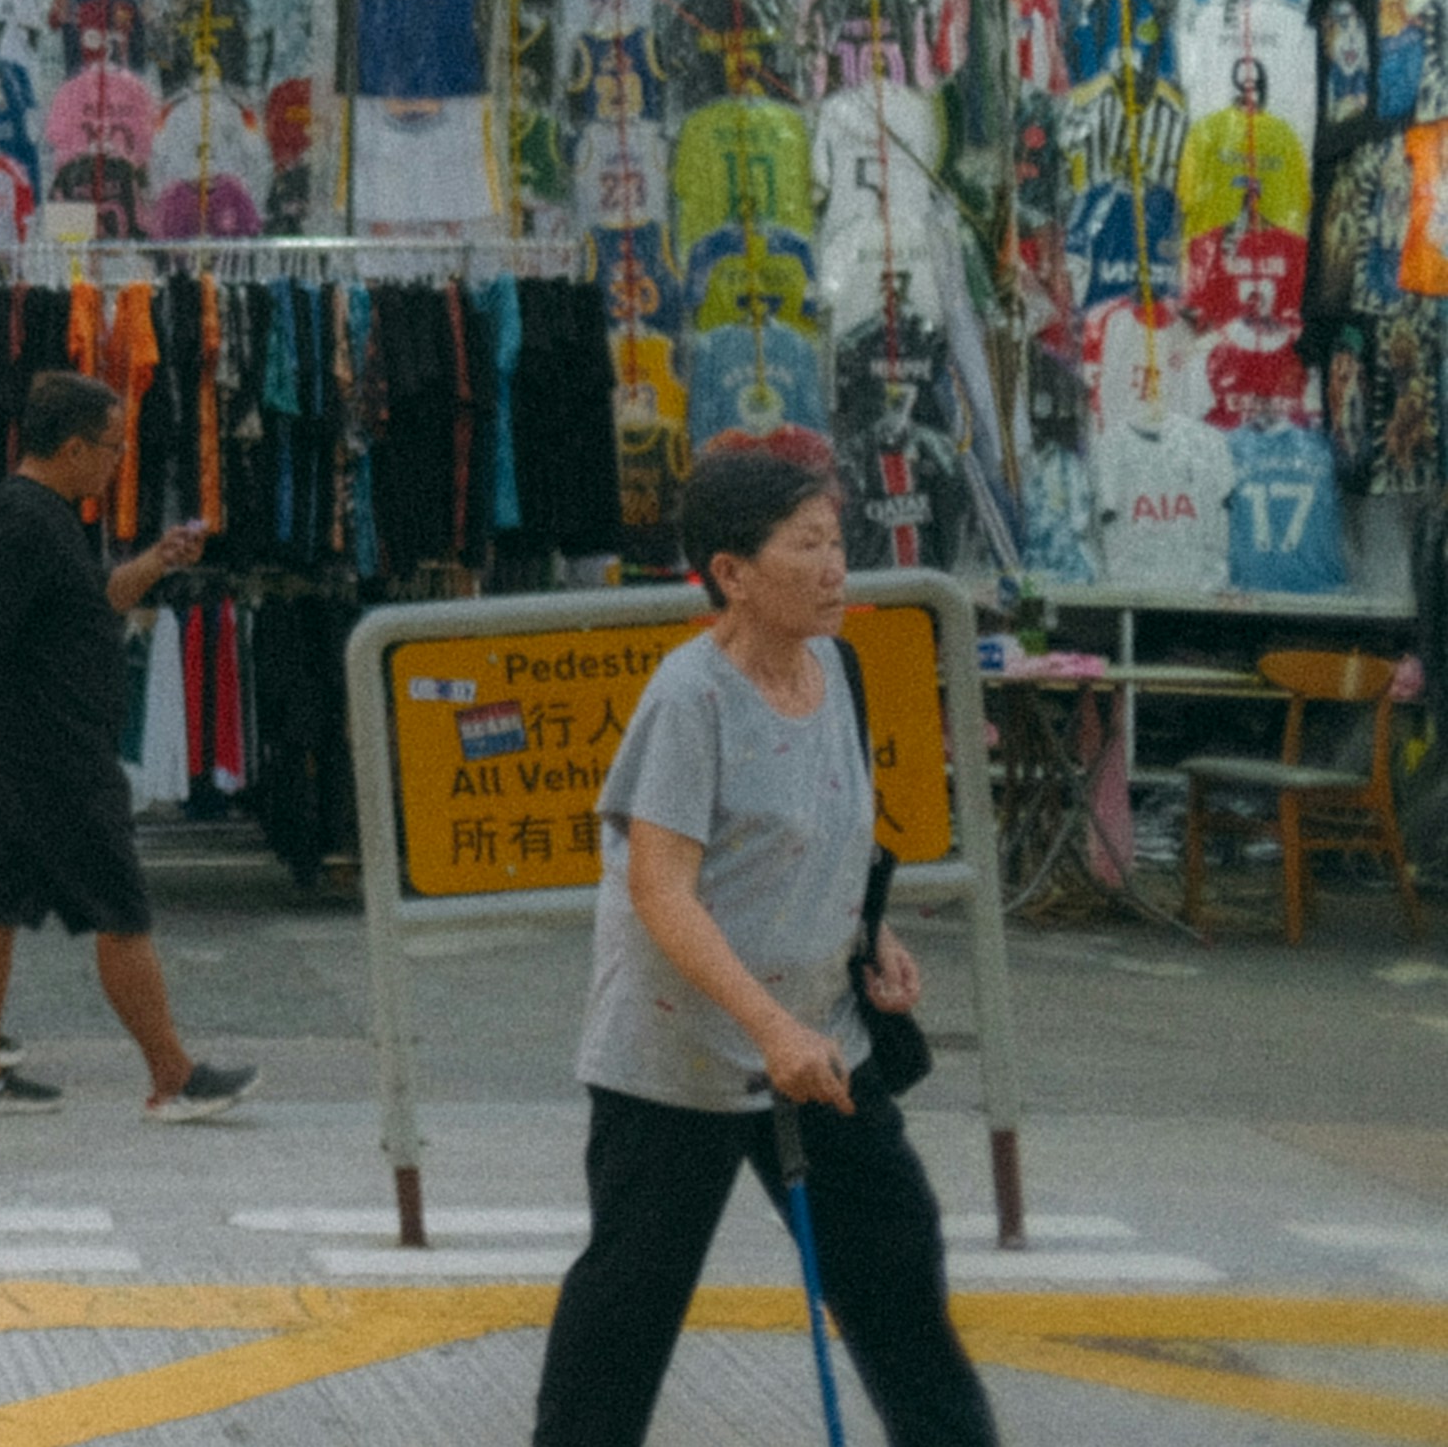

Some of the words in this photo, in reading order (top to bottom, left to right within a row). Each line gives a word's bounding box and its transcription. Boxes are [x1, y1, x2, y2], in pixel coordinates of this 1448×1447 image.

[1133, 492, 1198, 523] AIA
[1240, 482, 1315, 552] 17
[505, 641, 665, 685] Pedestri
[451, 765, 503, 798] All
[518, 756, 609, 793] Vehi
